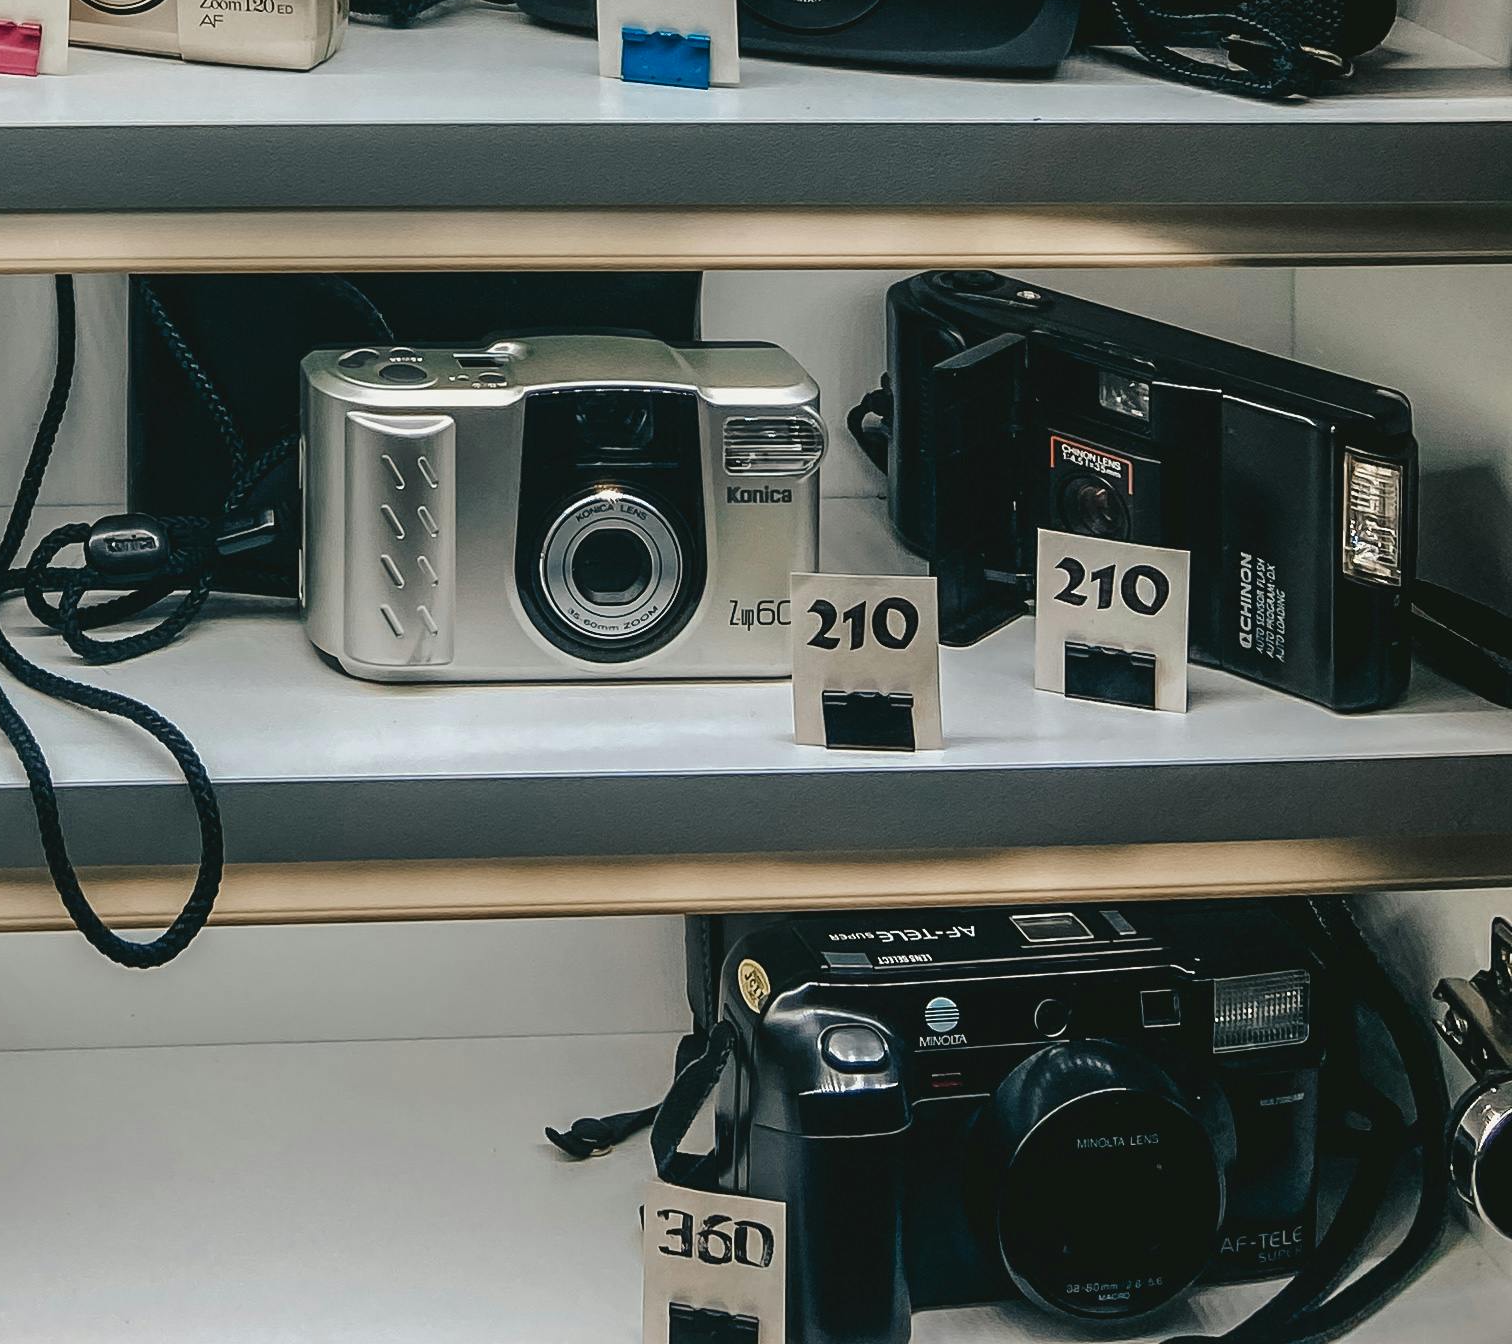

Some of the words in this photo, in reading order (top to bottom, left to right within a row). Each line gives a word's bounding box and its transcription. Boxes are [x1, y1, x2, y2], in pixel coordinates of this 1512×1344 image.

[199, 14, 224, 28] AF
[725, 485, 793, 505] Konica
[574, 503, 615, 523] KONICA
[620, 504, 649, 522] LENS
[1053, 557, 1170, 615] 210
[1239, 551, 1252, 632] CHINON
[623, 605, 659, 630] ZOOM
[806, 596, 920, 652] 210
[875, 925, 977, 943] AF-TELE
[919, 1034, 968, 1048] MINOLTA
[1076, 1135, 1125, 1150] MINOLTA
[1130, 1133, 1160, 1147] LENS
[656, 1208, 775, 1268] 360
[1220, 1225, 1304, 1255] AF-TELE
